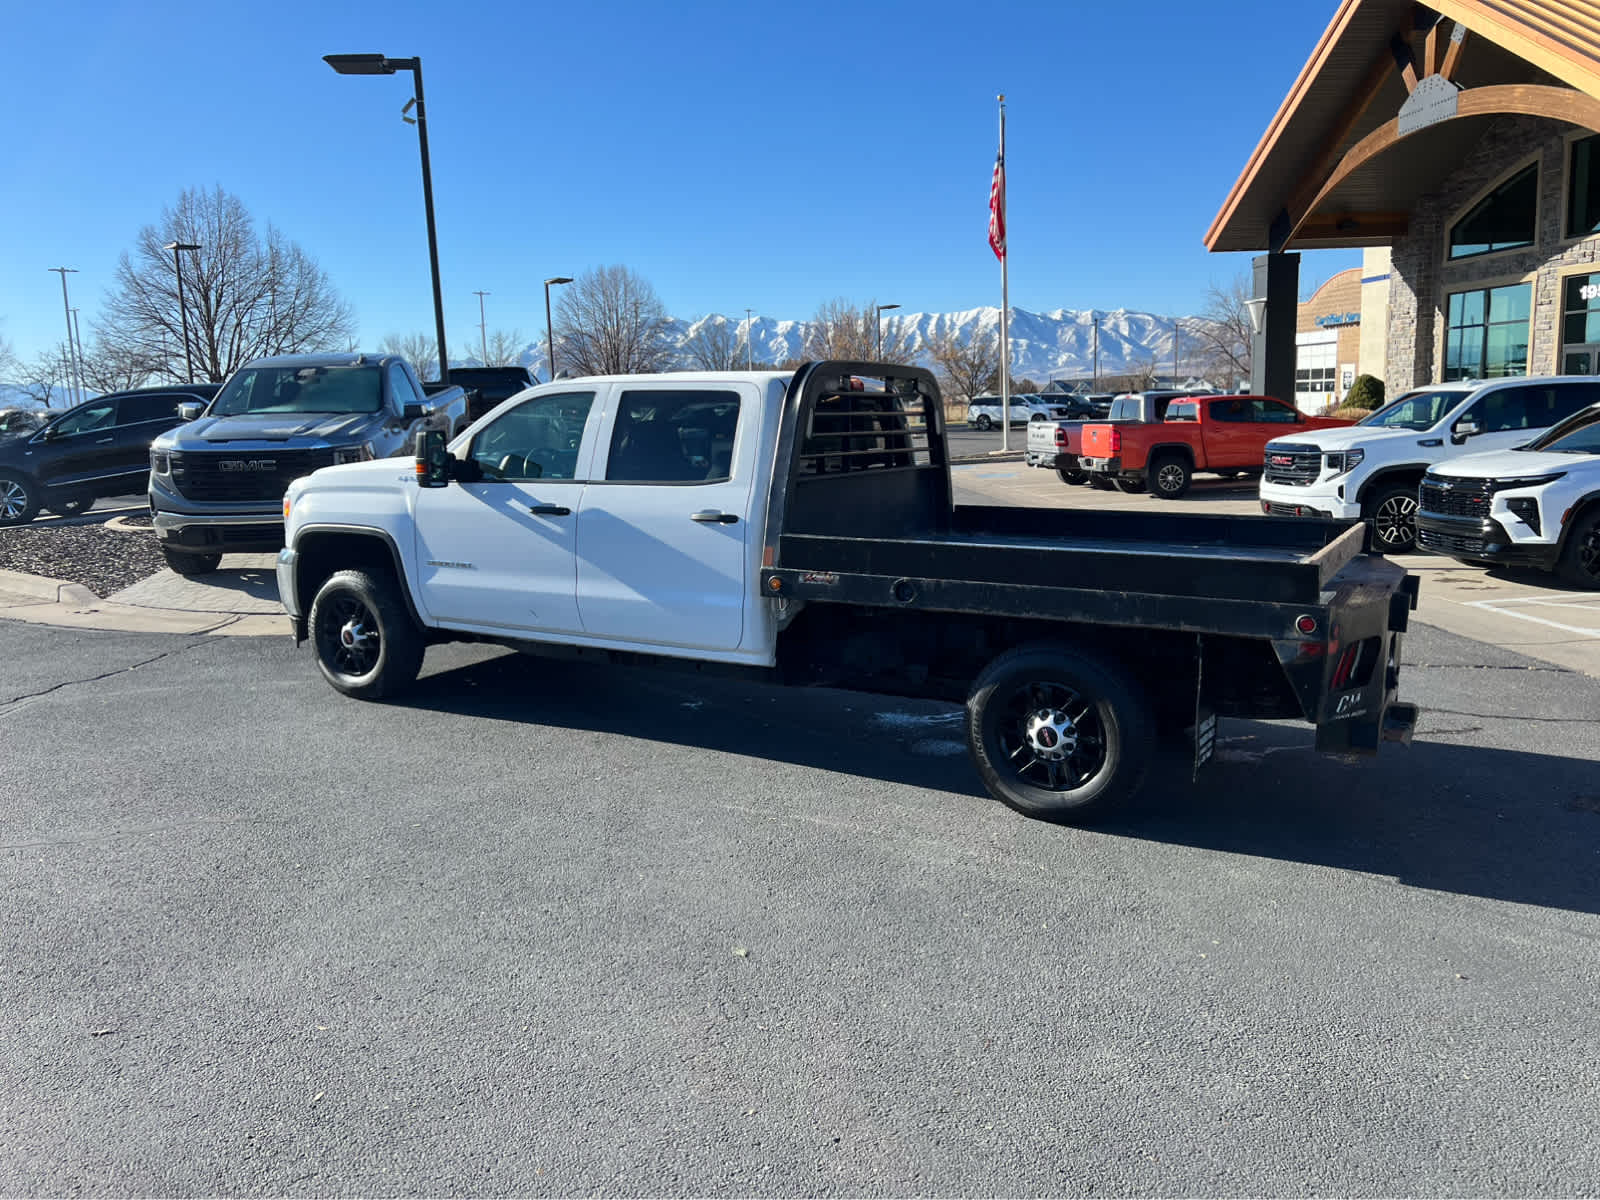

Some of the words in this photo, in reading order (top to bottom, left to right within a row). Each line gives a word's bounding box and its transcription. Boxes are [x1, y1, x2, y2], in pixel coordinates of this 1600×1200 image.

[1315, 313, 1344, 327] Certified
[218, 459, 277, 472] GMC
[1271, 454, 1293, 465] GMC
